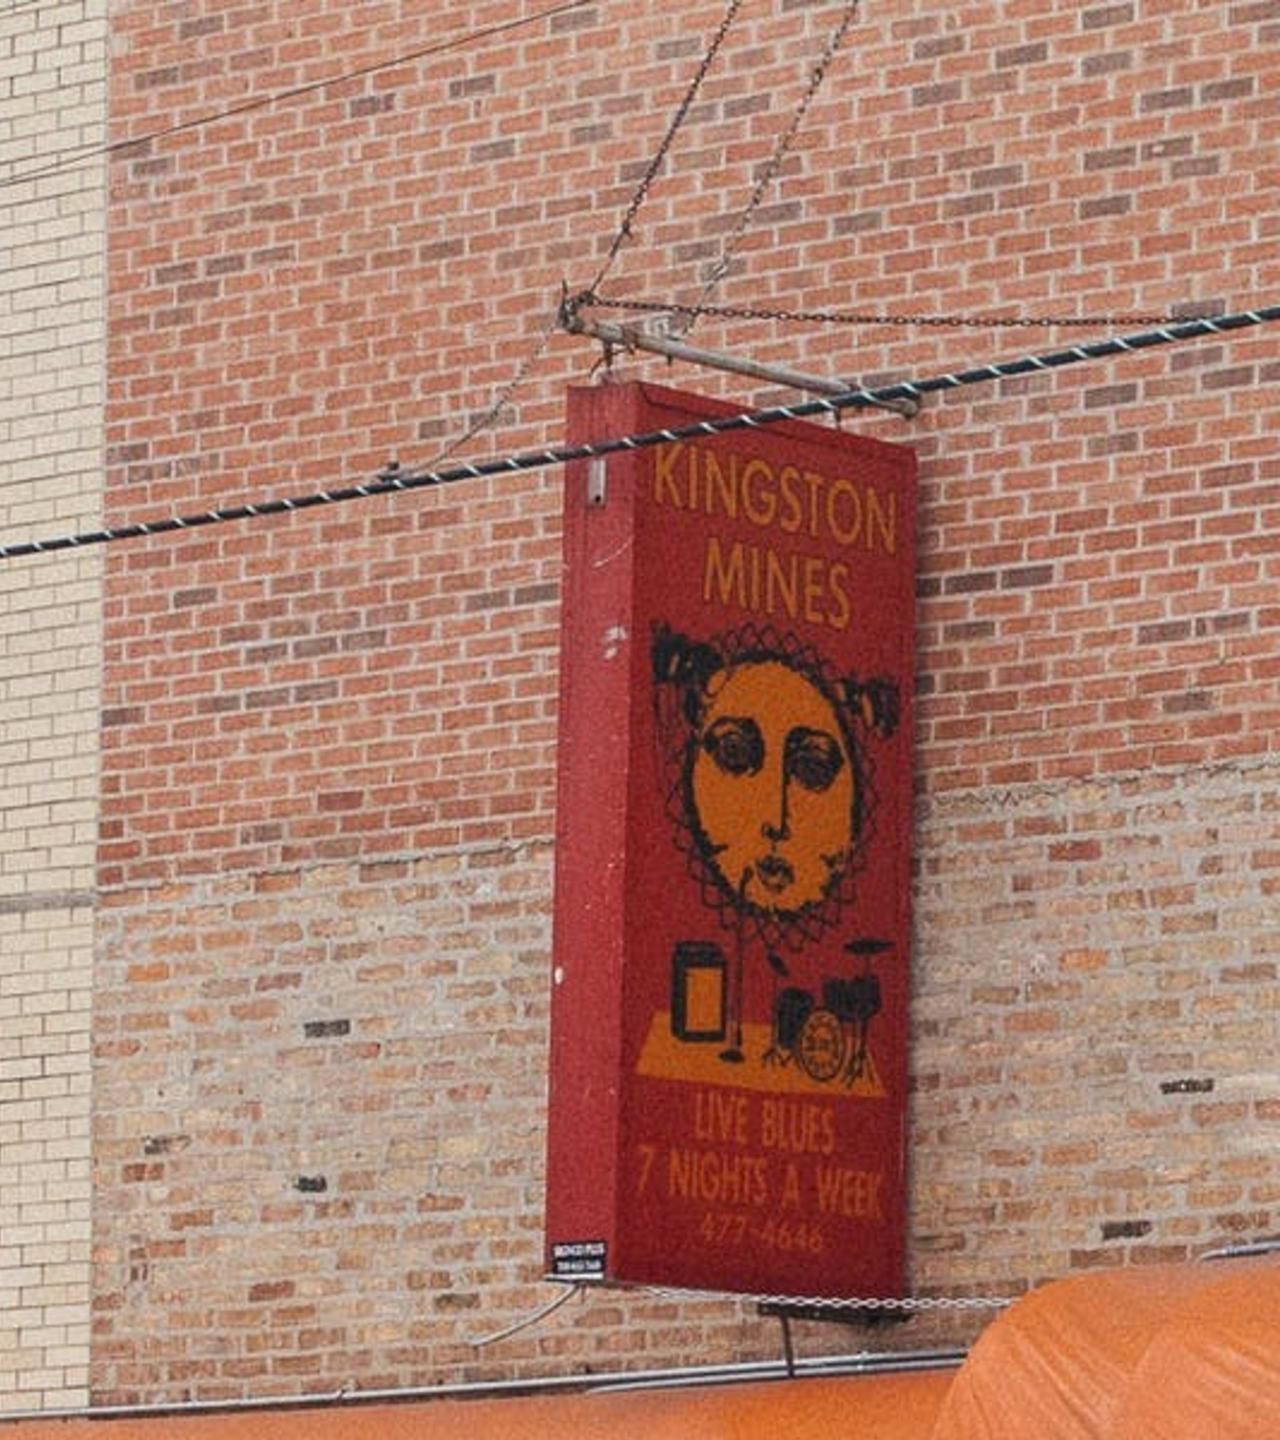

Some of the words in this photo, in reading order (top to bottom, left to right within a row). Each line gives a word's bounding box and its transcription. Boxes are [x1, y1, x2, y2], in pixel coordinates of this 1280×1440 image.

[653, 442, 897, 554] KINGSTON
[703, 537, 851, 629] MINES
[695, 1092, 747, 1145] LIVE
[761, 1099, 834, 1155] BLUES
[637, 1144, 655, 1192] 7
[669, 1149, 768, 1206] NIGHTS
[782, 1164, 801, 1211] A
[816, 1164, 883, 1220] WEEK
